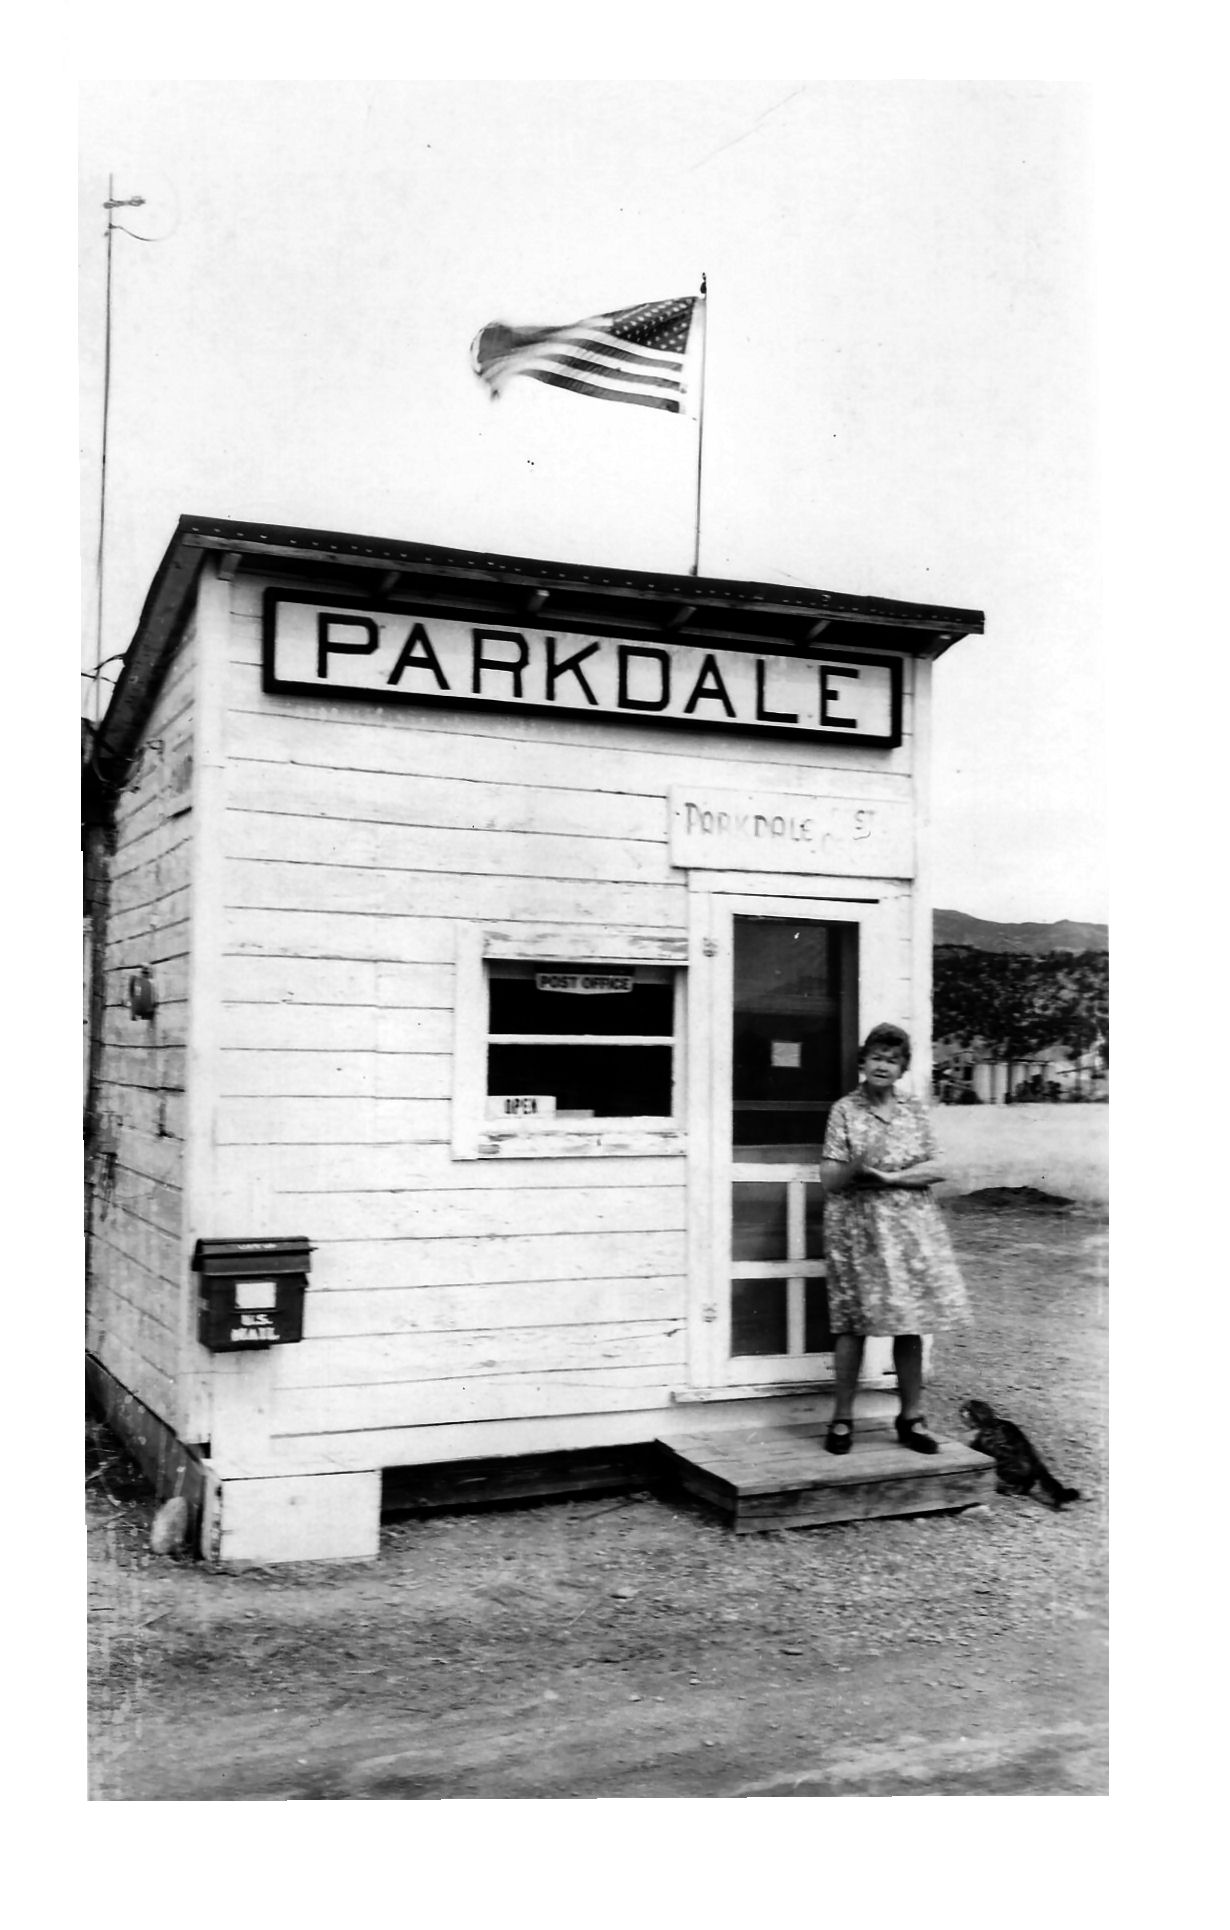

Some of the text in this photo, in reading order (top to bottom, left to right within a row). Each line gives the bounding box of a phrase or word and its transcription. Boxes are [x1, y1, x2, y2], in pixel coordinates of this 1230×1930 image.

[317, 611, 861, 729] PARKDALE
[540, 975, 631, 990] POST OFFICE
[504, 1098, 538, 1115] OPEN
[230, 1326, 280, 1342] MAIL
